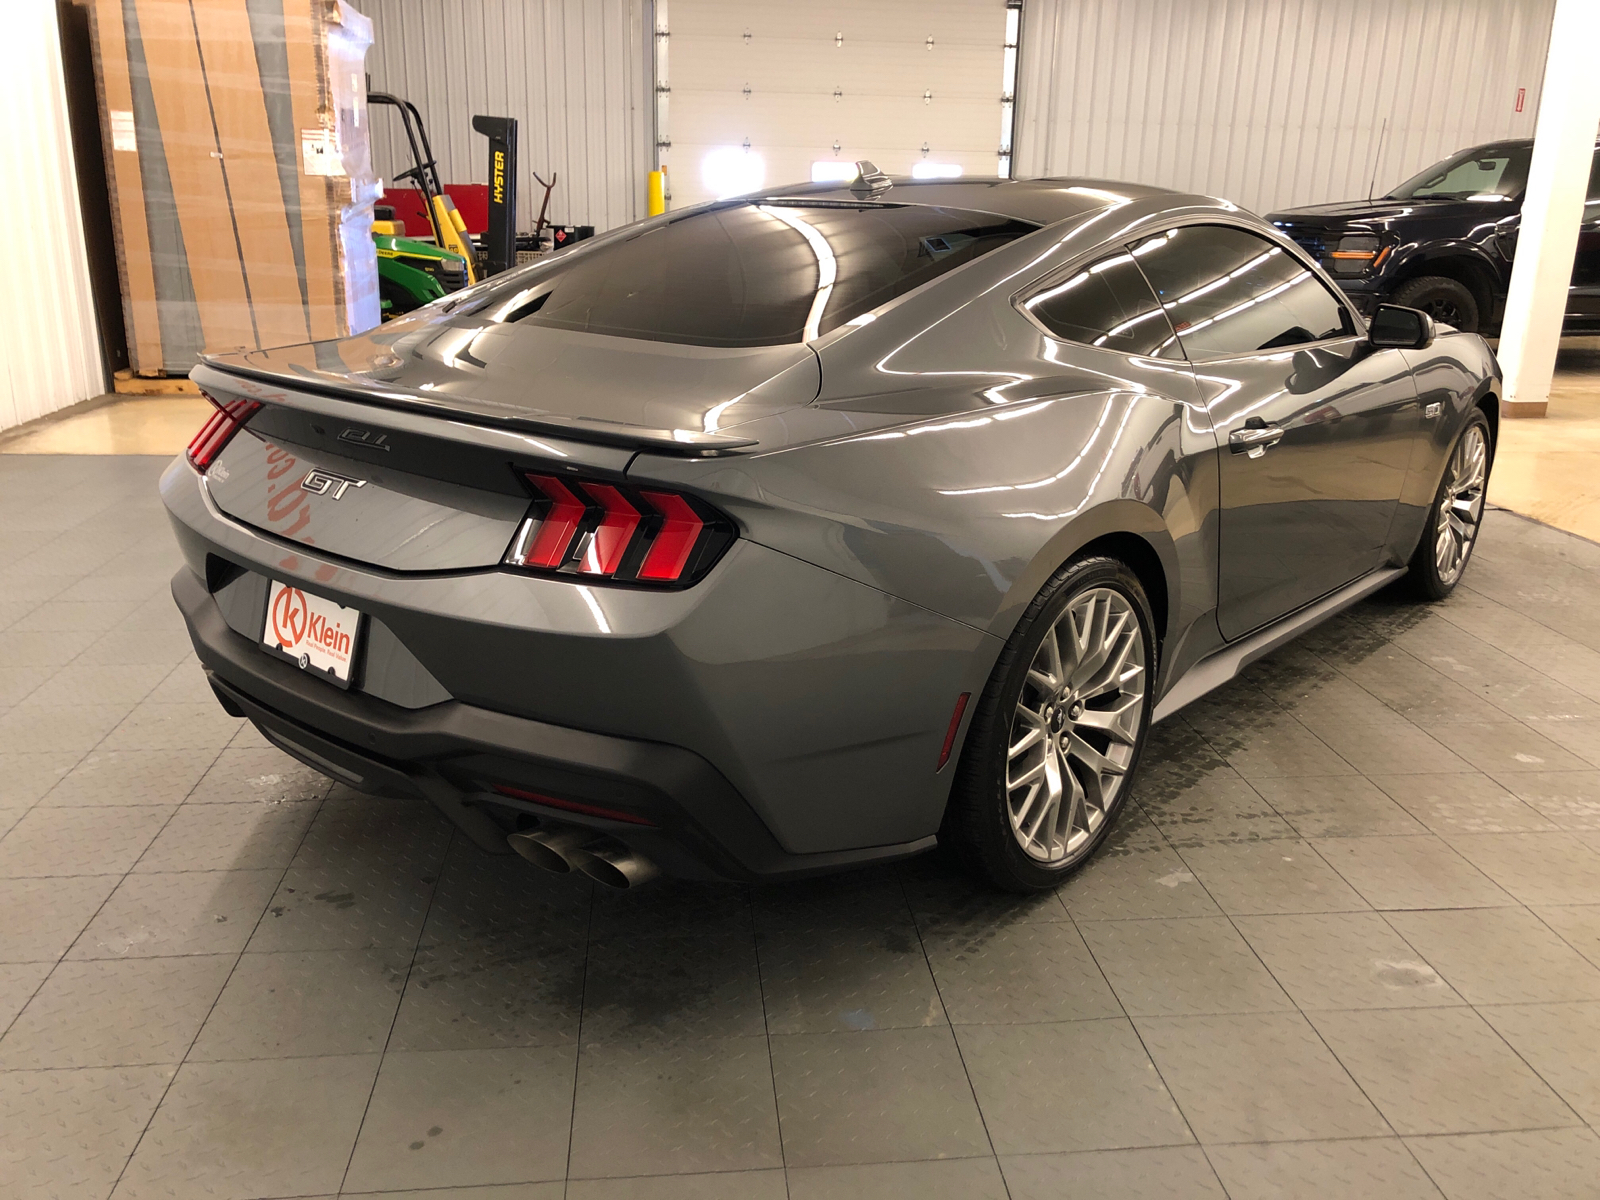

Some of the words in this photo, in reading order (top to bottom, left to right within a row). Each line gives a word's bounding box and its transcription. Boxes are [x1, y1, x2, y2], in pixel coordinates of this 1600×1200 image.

[494, 151, 504, 204] HYSTER
[300, 467, 367, 500] GT
[307, 612, 350, 654] Klein
